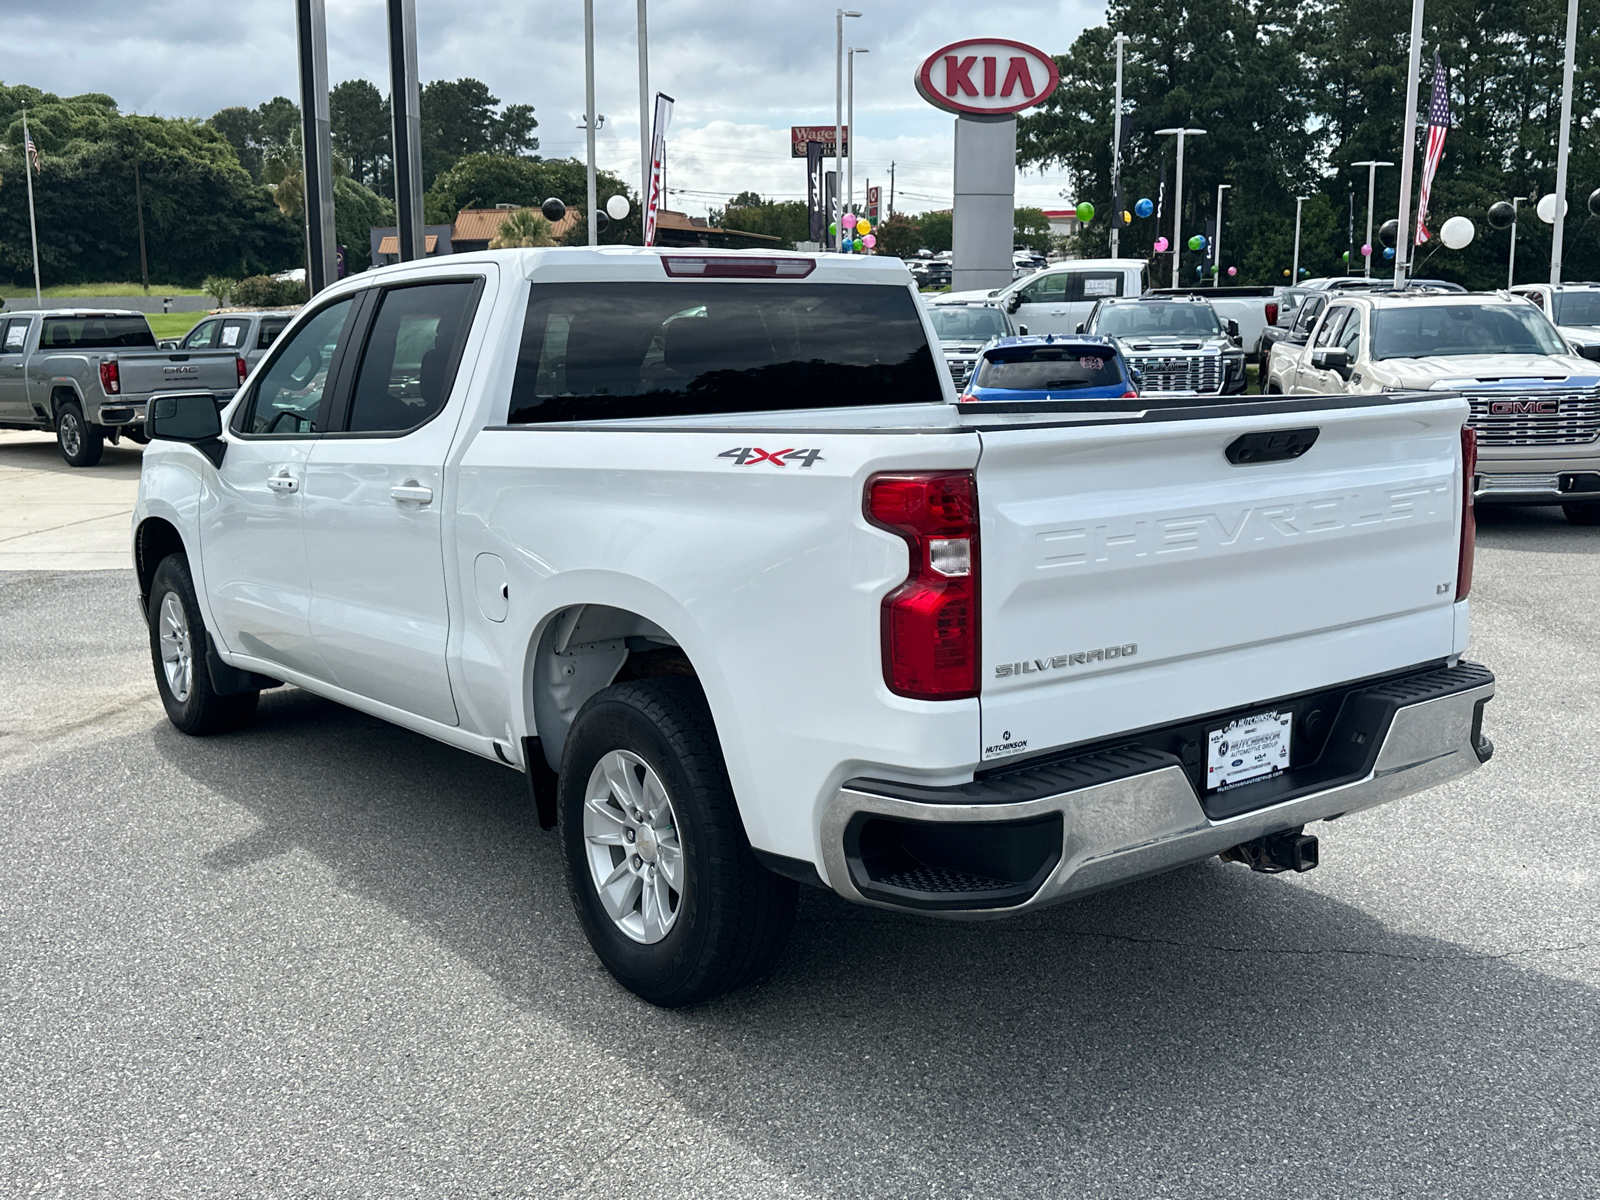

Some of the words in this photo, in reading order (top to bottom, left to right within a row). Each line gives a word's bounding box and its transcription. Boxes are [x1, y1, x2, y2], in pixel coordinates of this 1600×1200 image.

[944, 55, 1036, 98] KIA
[163, 366, 200, 374] GMC
[1147, 362, 1189, 372] GMC
[1492, 401, 1557, 414] GMC
[1035, 482, 1449, 569] CHEVROLET
[1436, 581, 1453, 595] LT
[995, 643, 1138, 678] SILVERADO
[985, 740, 1028, 754] HUTCHINSON
[1230, 743, 1261, 757] AUTOMOTIVE
[1261, 740, 1278, 750] GROUP
